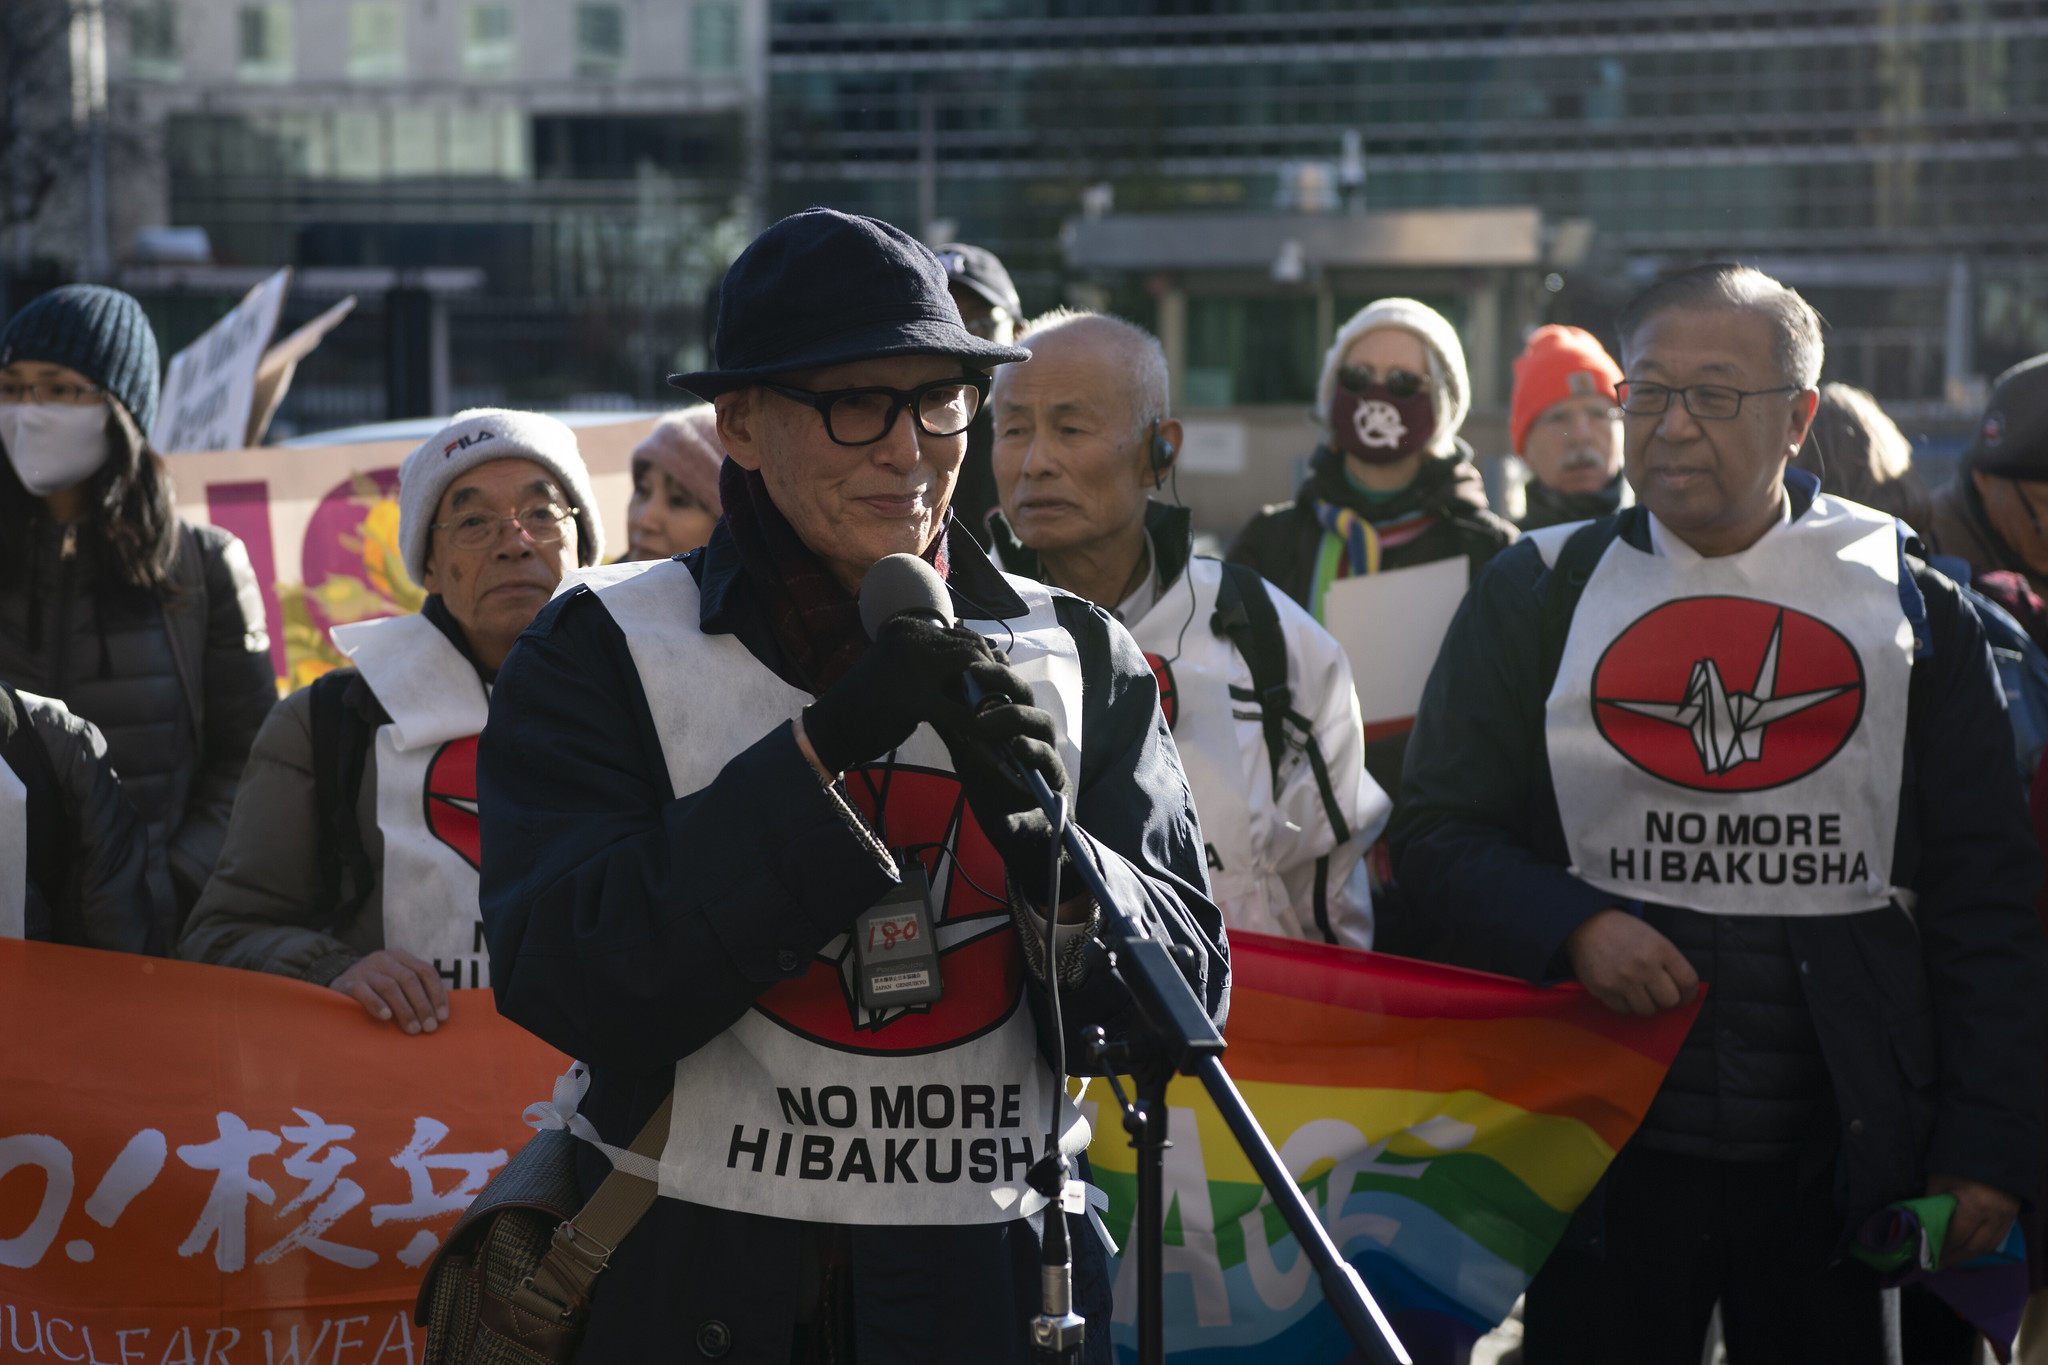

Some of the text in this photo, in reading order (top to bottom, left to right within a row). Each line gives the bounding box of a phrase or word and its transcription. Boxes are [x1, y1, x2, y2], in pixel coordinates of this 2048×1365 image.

[444, 431, 495, 458] FILA
[1646, 811, 1841, 846] NO MORE
[1610, 847, 1869, 885] HIBAKUSHA
[776, 1084, 1021, 1129] NO MORE
